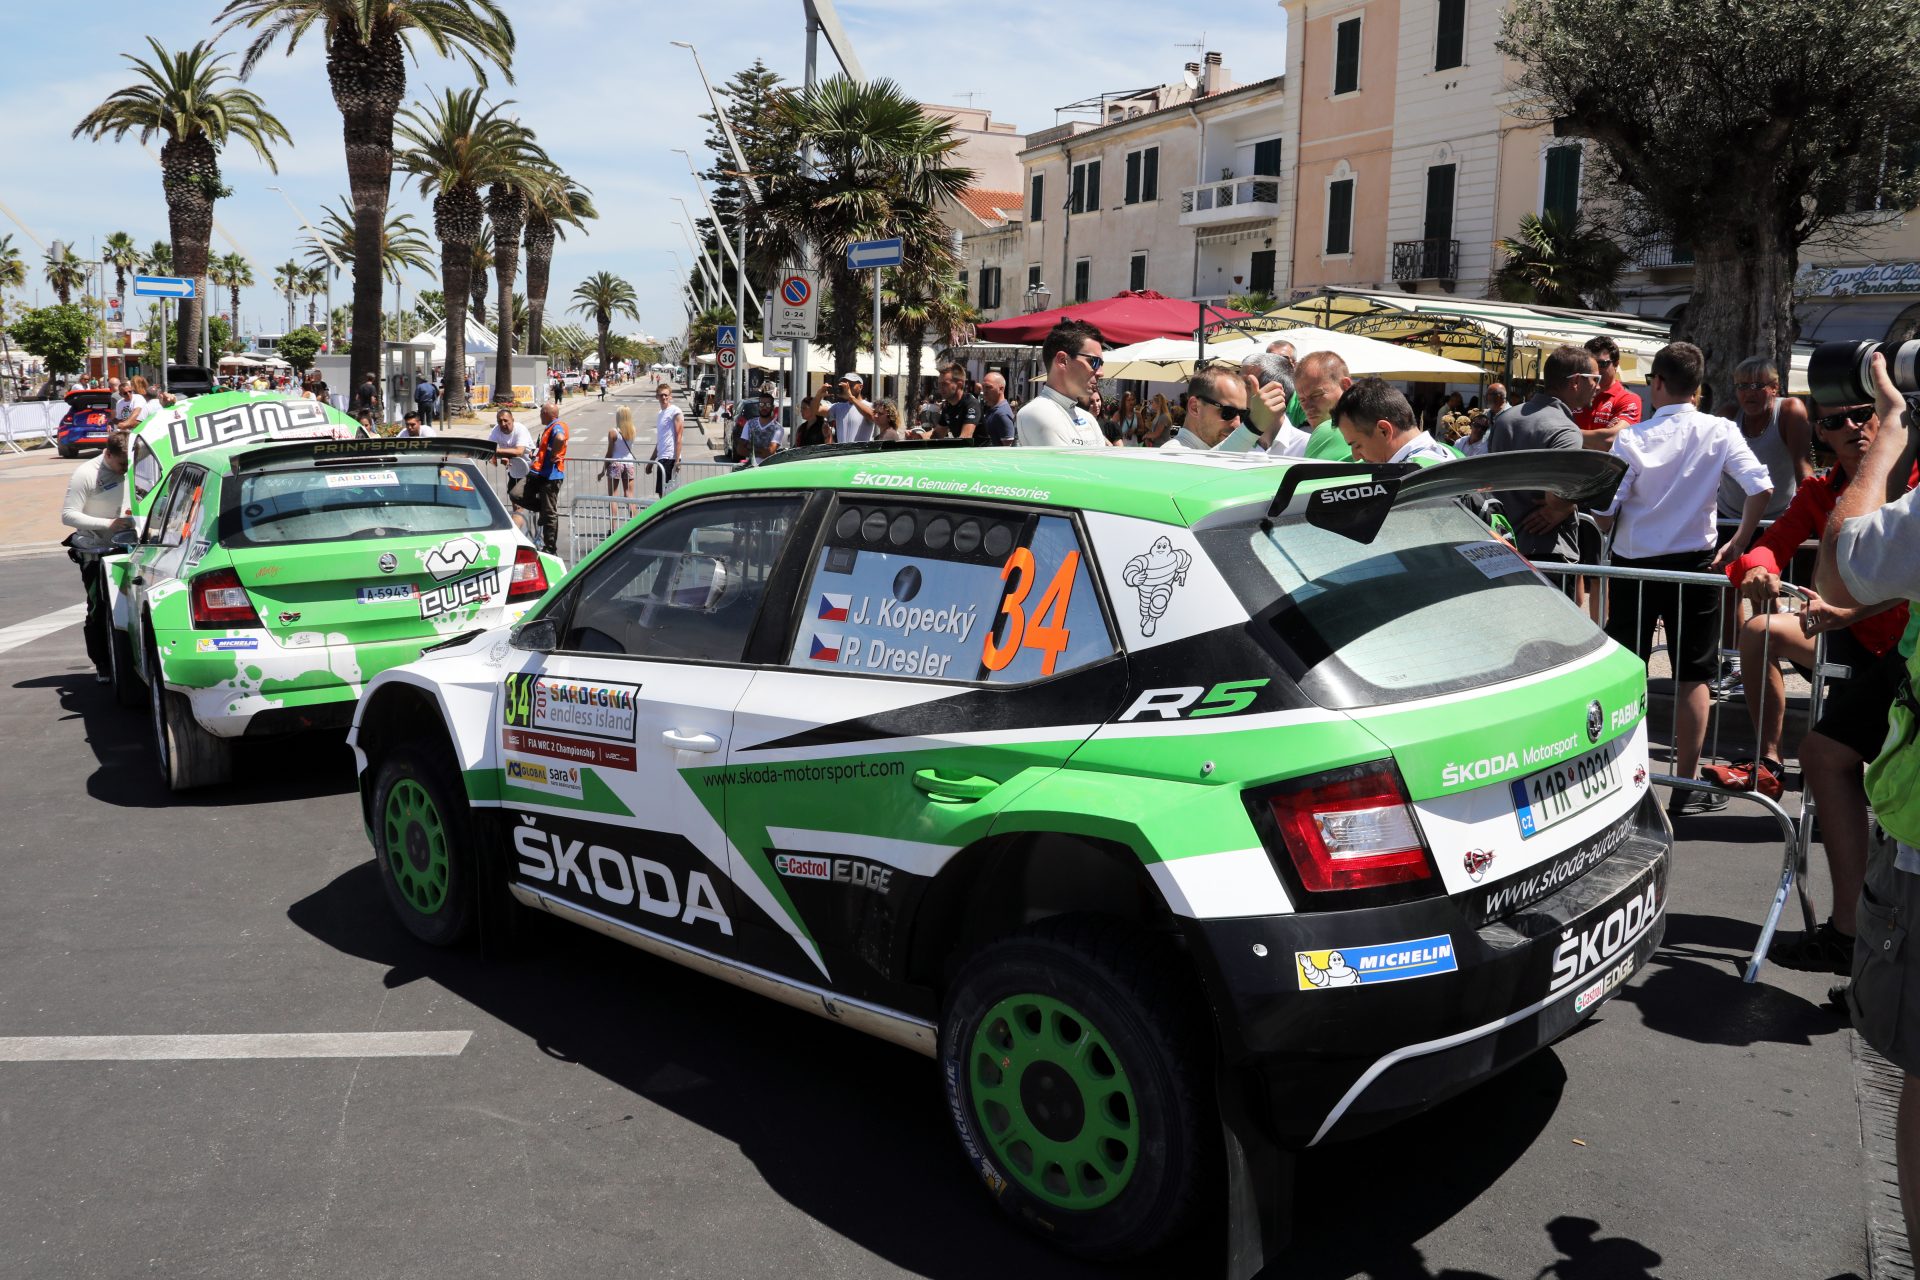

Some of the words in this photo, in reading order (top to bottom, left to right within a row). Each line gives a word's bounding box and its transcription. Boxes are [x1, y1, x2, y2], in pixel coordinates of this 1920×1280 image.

[722, 354, 734, 362] 30
[313, 440, 432, 454] PRINTSPORT
[329, 473, 394, 482] SARDEGNA
[441, 470, 475, 491] 32
[851, 471, 914, 488] ŠKODA
[916, 477, 968, 493] Genuine
[968, 481, 1051, 500] Accessories
[1320, 483, 1388, 504] ŠKODA
[853, 596, 871, 626] J.
[876, 598, 976, 643] Kopecký
[981, 546, 1081, 677] 34
[219, 639, 259, 647] MICHELIN
[843, 636, 861, 666] P.
[867, 639, 952, 677] Dresler
[505, 673, 532, 726] 34
[536, 681, 546, 719] 2017
[550, 683, 633, 711] SARDEGNA
[1117, 678, 1271, 722] R5
[550, 705, 593, 726] endless
[595, 709, 633, 732] island
[1611, 699, 1639, 732] FABIA
[527, 738, 537, 748] FIA
[538, 740, 551, 751] WRC
[551, 742, 555, 751] 2
[556, 743, 596, 760] Championship
[1442, 752, 1519, 787] ŠKODA
[1523, 732, 1578, 766] Motorsport
[522, 766, 547, 780] GLOBAL
[549, 768, 569, 782] sara
[703, 760, 905, 788] www.skoda-motorsport.com
[1534, 769, 1573, 821] 11R
[1577, 748, 1616, 800] 0331
[1521, 815, 1533, 830] CZ
[513, 813, 734, 937] ŠKODA
[789, 857, 828, 876] Castrol
[832, 859, 895, 895] EDGE
[1486, 812, 1636, 914] www.skoda-auto.com
[1550, 882, 1656, 992] ŠKODA
[1359, 944, 1451, 970] MICHELIN
[1582, 981, 1603, 1008] Castrol
[1603, 951, 1635, 996] EDGE
[946, 1061, 980, 1160] MICHELIN
